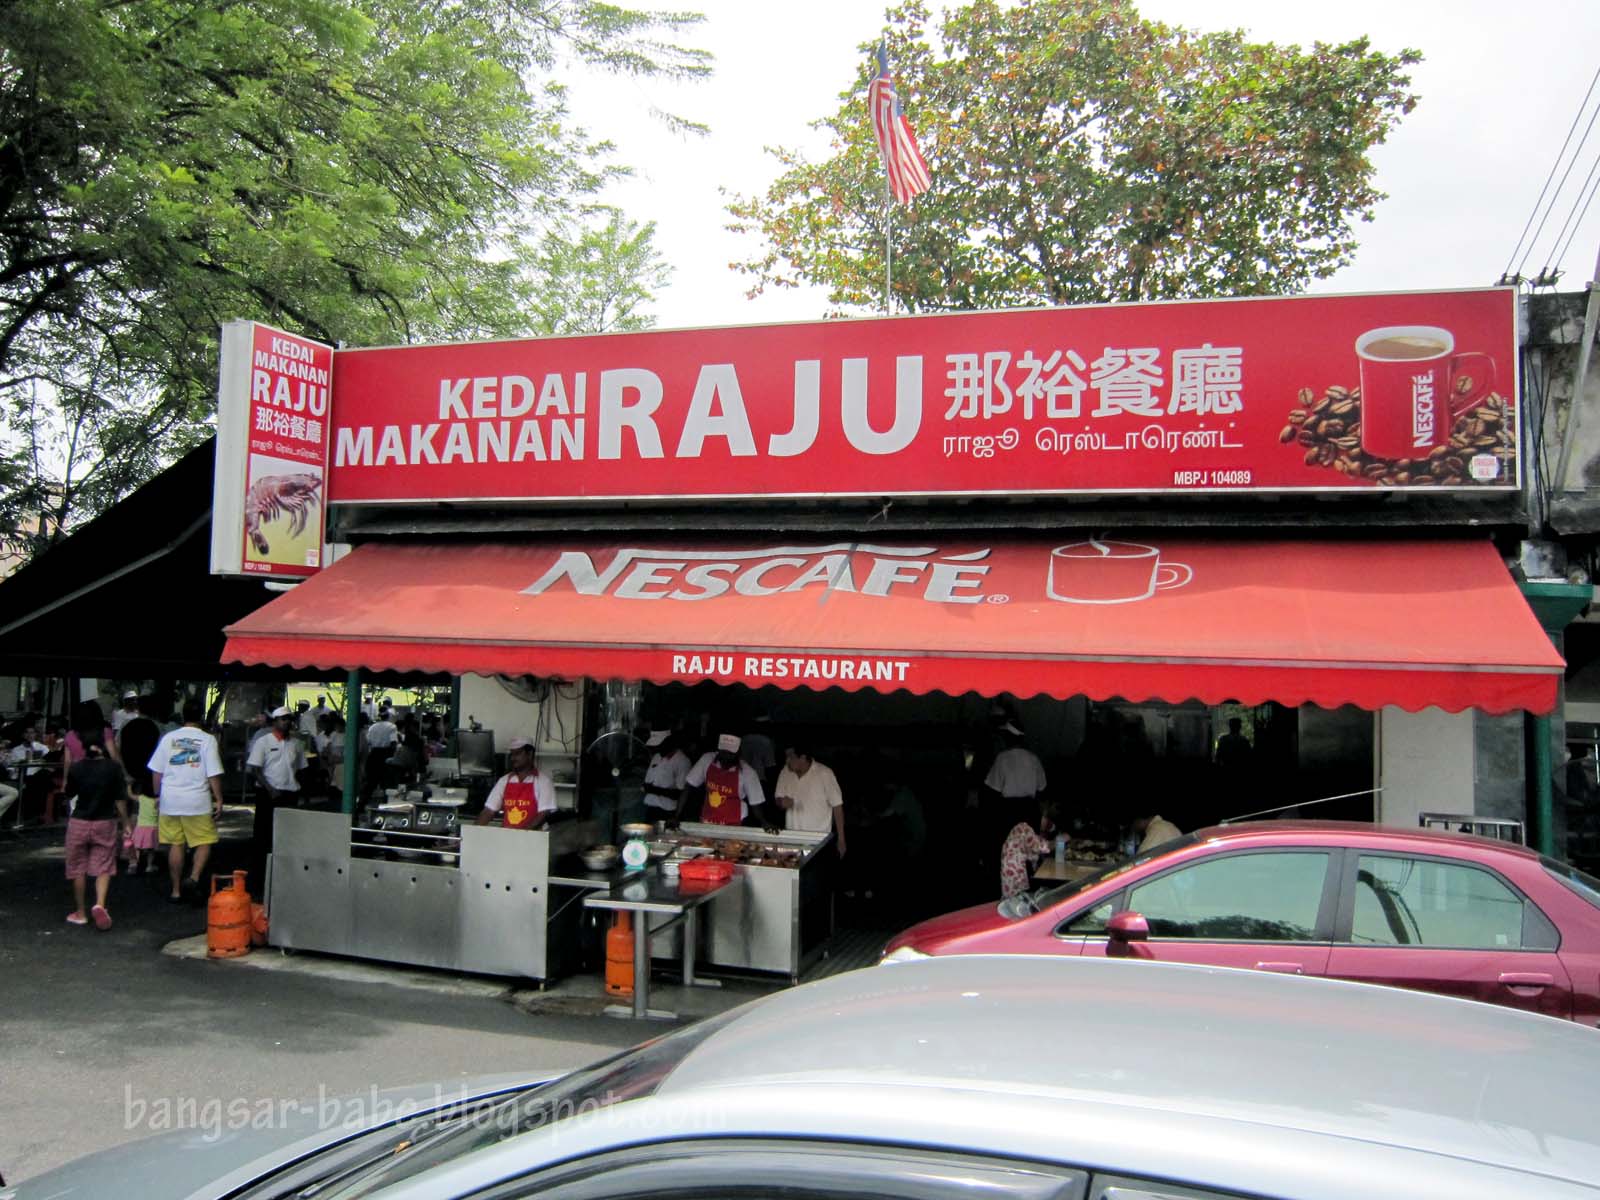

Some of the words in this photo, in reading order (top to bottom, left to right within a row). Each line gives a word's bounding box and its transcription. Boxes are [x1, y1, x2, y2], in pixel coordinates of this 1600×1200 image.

[255, 350, 328, 386] MAKANAN
[272, 337, 315, 364] KEDAI
[253, 369, 327, 416] RAJU
[439, 372, 587, 420] KEDAI
[944, 343, 1243, 420] 那裕餐廳
[598, 355, 923, 460] RAJU
[1412, 374, 1434, 448] NESCAFÉ
[335, 418, 585, 467] MAKANAN
[1174, 471, 1207, 485] MBPJ
[1211, 470, 1251, 484] 104089
[517, 543, 991, 604] NESCAFÉ
[672, 655, 733, 675] RAJU
[744, 657, 910, 681] RESTAURANT
